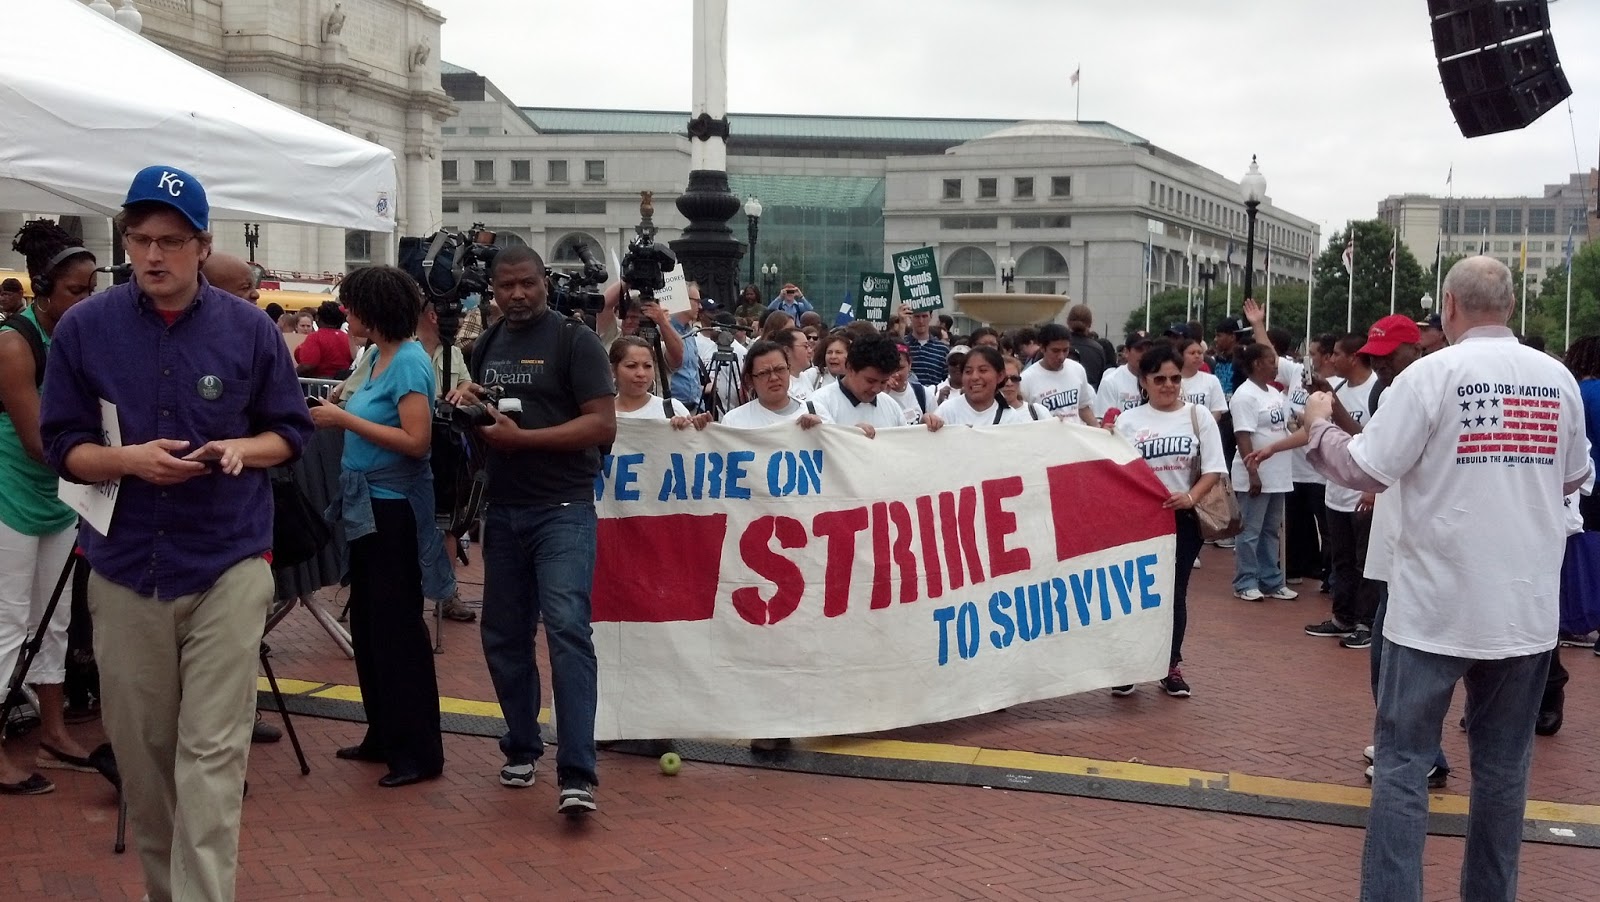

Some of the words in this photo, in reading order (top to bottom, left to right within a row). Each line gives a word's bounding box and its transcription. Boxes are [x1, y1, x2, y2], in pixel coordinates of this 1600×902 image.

[157, 171, 184, 197] KC
[903, 271, 932, 286] Stands
[910, 284, 930, 297] with
[863, 295, 887, 307] Stands
[866, 307, 883, 319] with
[484, 368, 532, 385] Dream
[1457, 383, 1490, 397] GOOD
[1494, 383, 1515, 395] JOBS
[1519, 385, 1560, 398] NATION!
[1042, 389, 1079, 411] STRIKE
[1135, 436, 1192, 460] STRIKE
[1456, 456, 1488, 465] REBUILD
[1490, 455, 1501, 463] THE
[657, 451, 756, 502] ARE
[766, 449, 823, 497] ON
[732, 476, 1031, 625] STRIKE
[933, 602, 980, 666] TO
[989, 554, 1161, 649] SURVIVE
